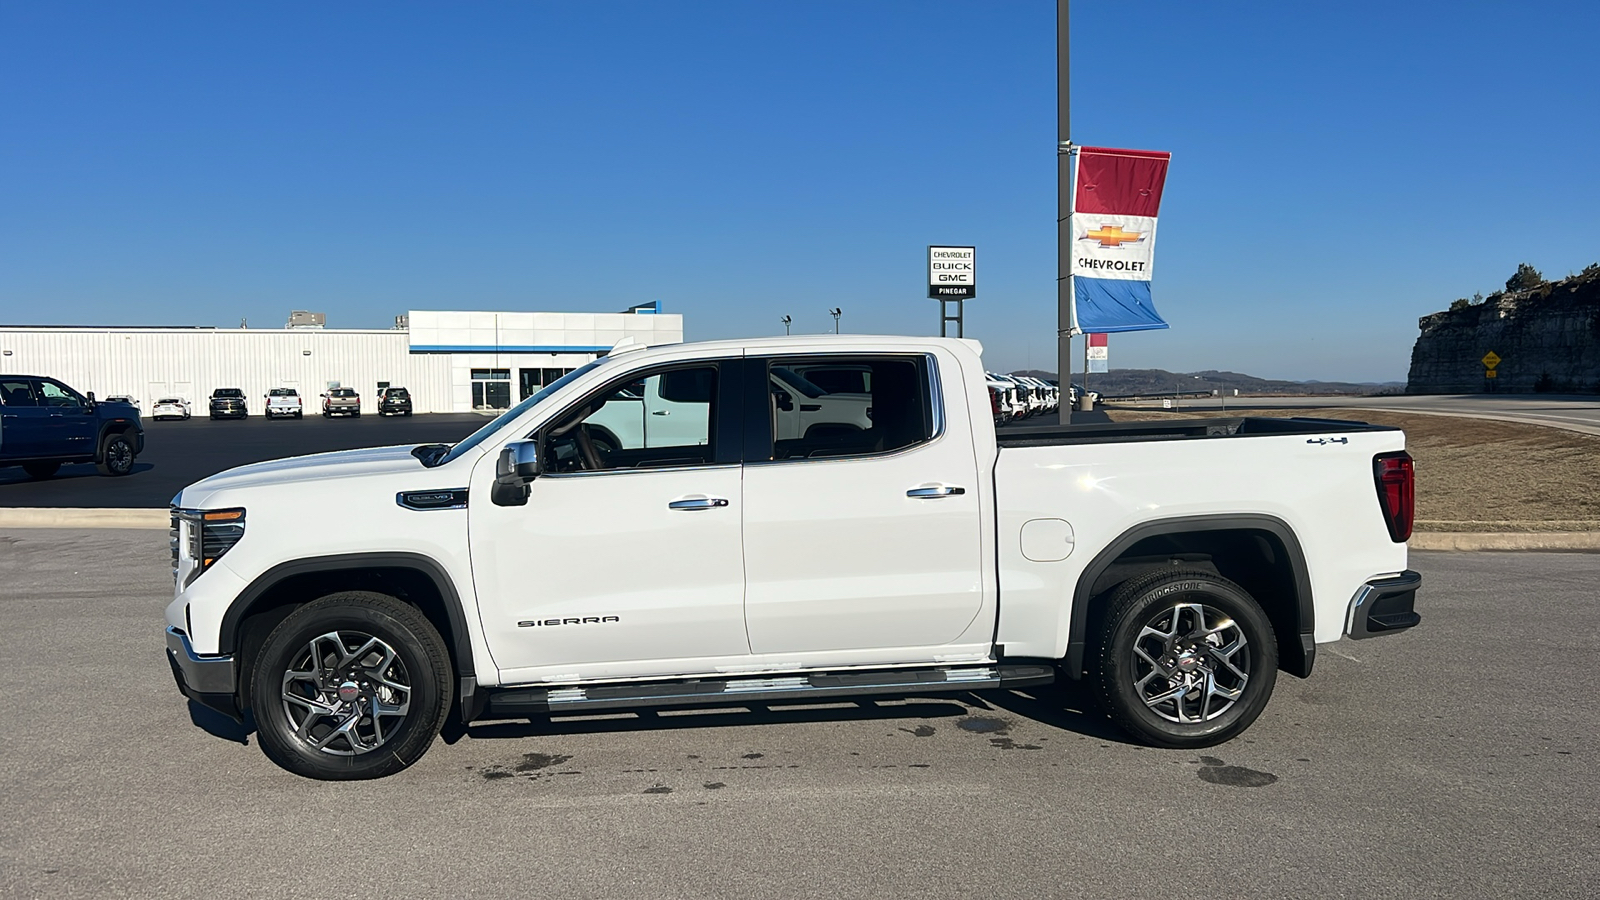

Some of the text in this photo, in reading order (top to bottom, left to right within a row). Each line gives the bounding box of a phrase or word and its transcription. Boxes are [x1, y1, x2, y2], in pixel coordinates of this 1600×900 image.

[933, 251, 972, 259] CHEVROLET
[933, 262, 972, 270] BUICK
[1078, 257, 1146, 272] CHEVROLET
[938, 274, 968, 282] GMC
[938, 287, 968, 295] PINEGAR
[517, 615, 620, 628] SIERRA
